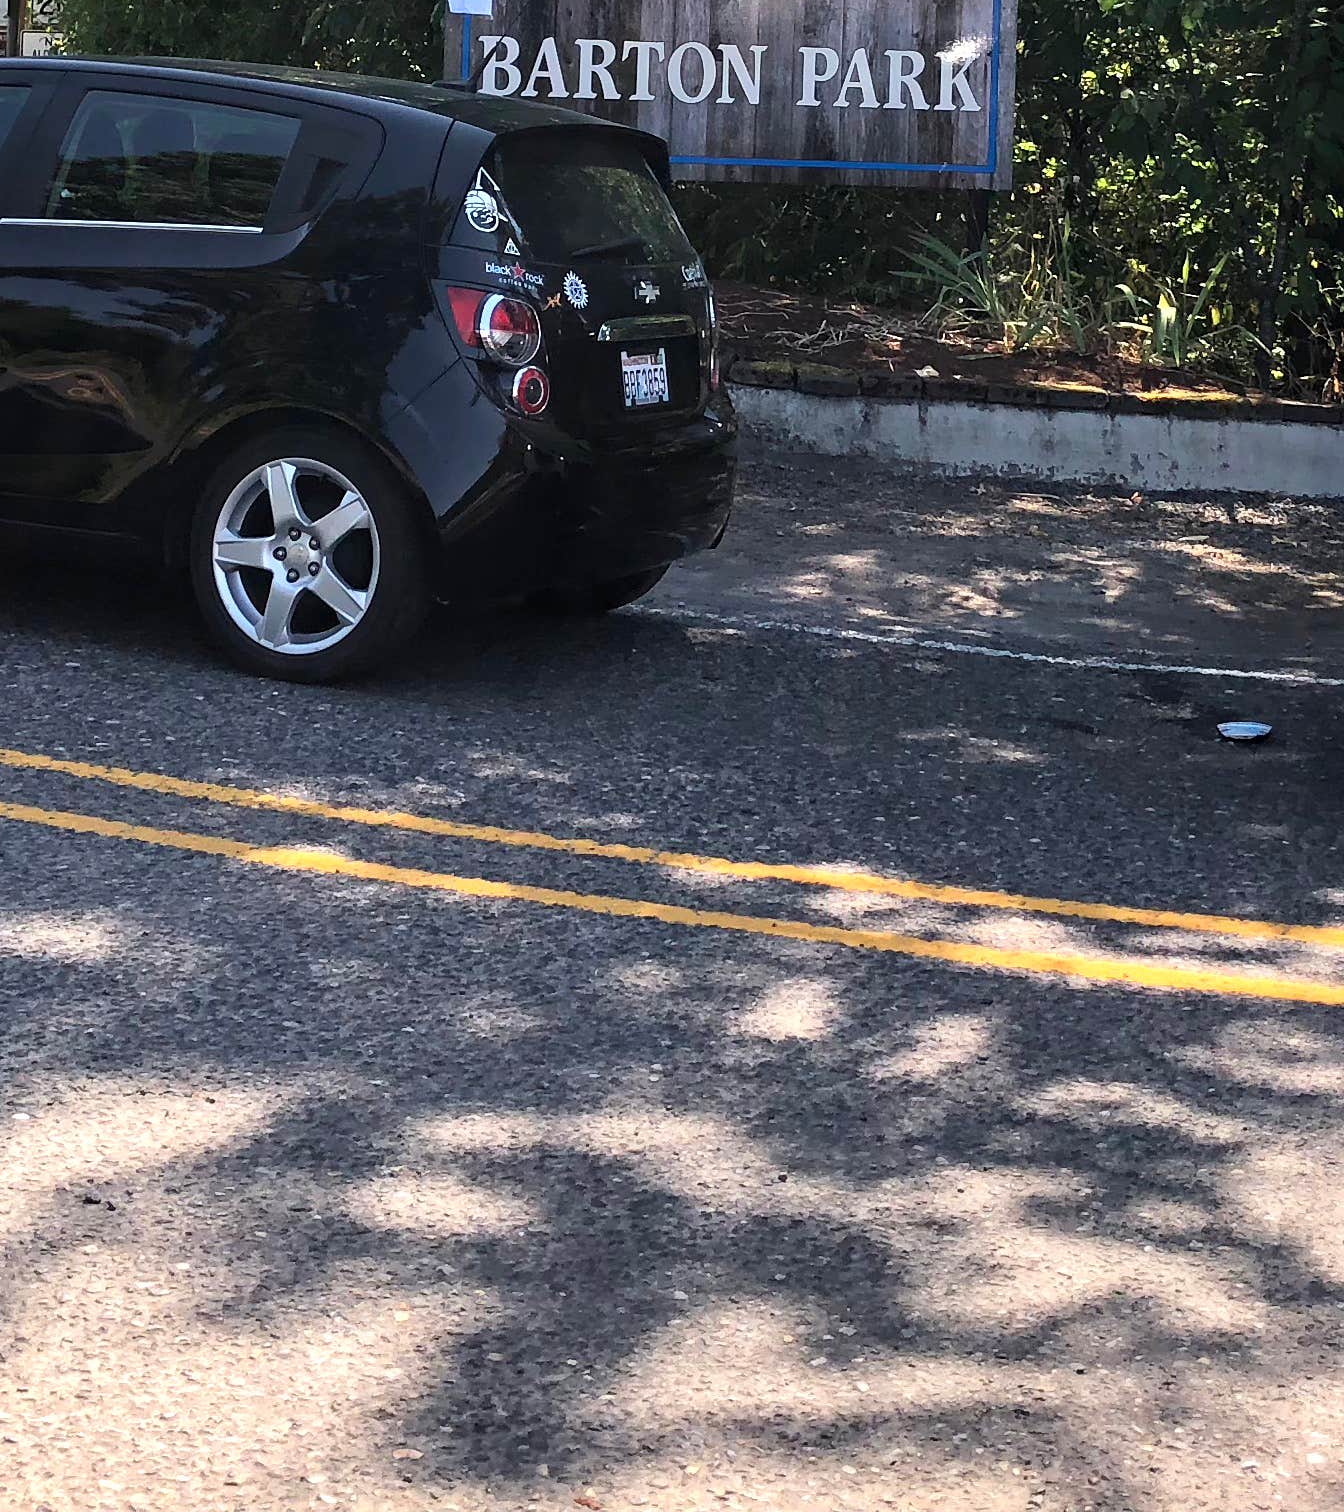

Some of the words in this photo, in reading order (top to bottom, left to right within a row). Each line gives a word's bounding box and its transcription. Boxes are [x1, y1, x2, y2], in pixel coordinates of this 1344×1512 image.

[477, 35, 768, 105] BARTON
[795, 45, 982, 113] PARK
[485, 261, 512, 276] black
[525, 272, 544, 286] rock
